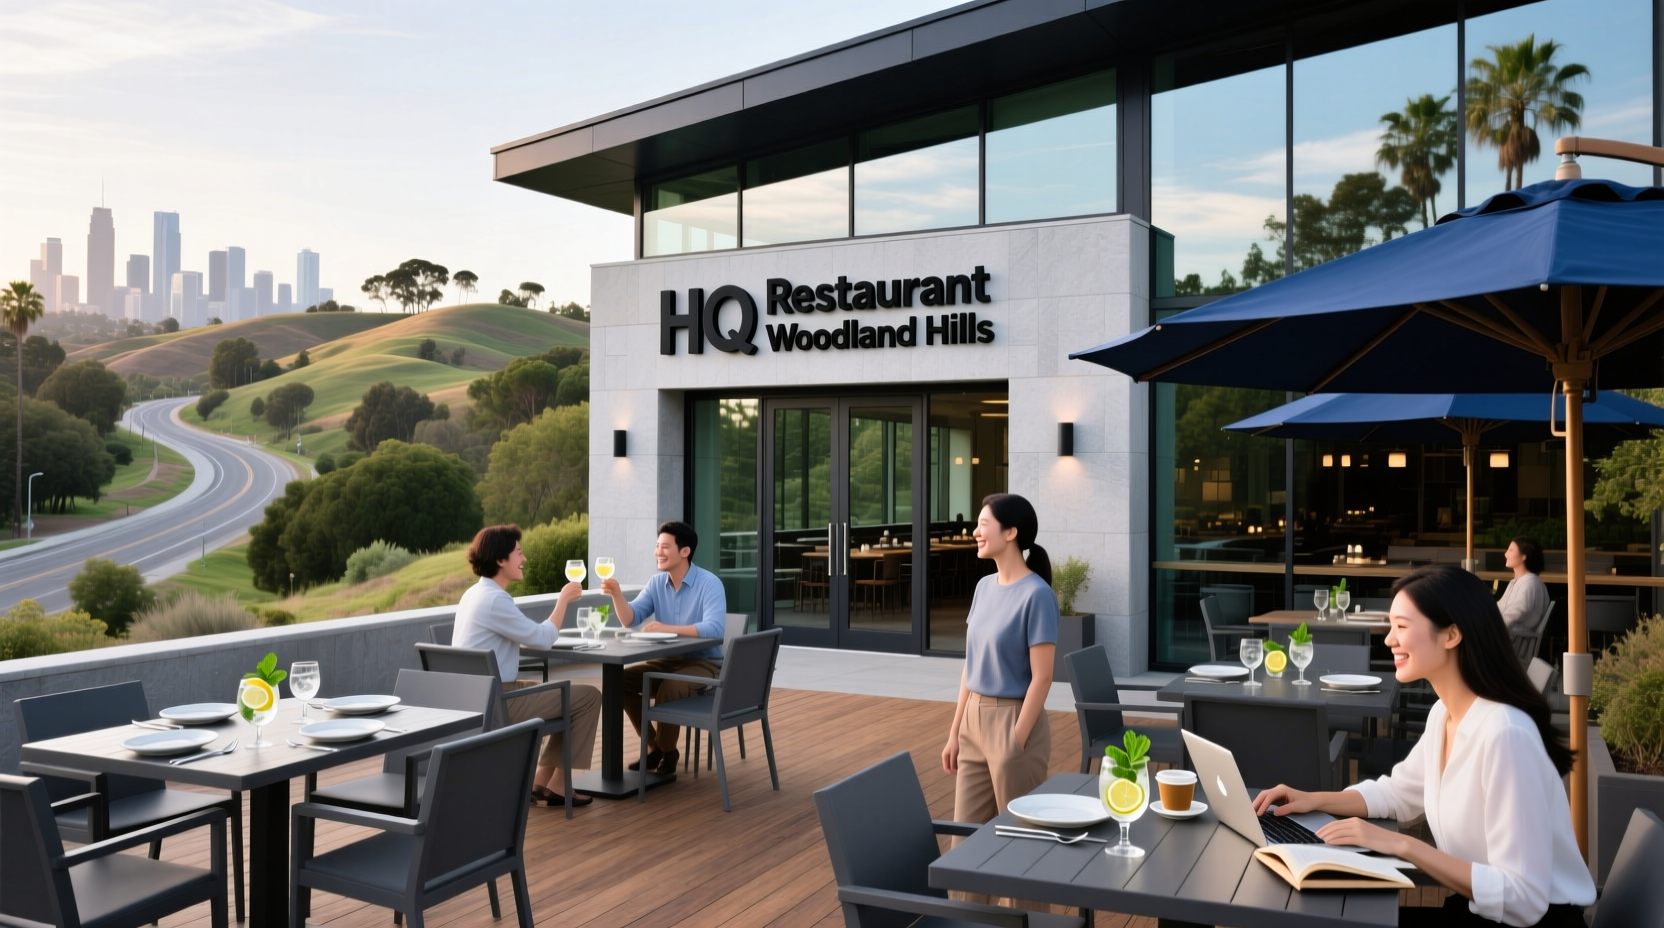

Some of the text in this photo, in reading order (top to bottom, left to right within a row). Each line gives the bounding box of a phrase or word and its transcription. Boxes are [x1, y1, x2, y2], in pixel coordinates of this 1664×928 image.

[766, 265, 992, 316] Restaurant
[660, 284, 759, 356] HQ
[765, 311, 996, 353] Woodland Hills
